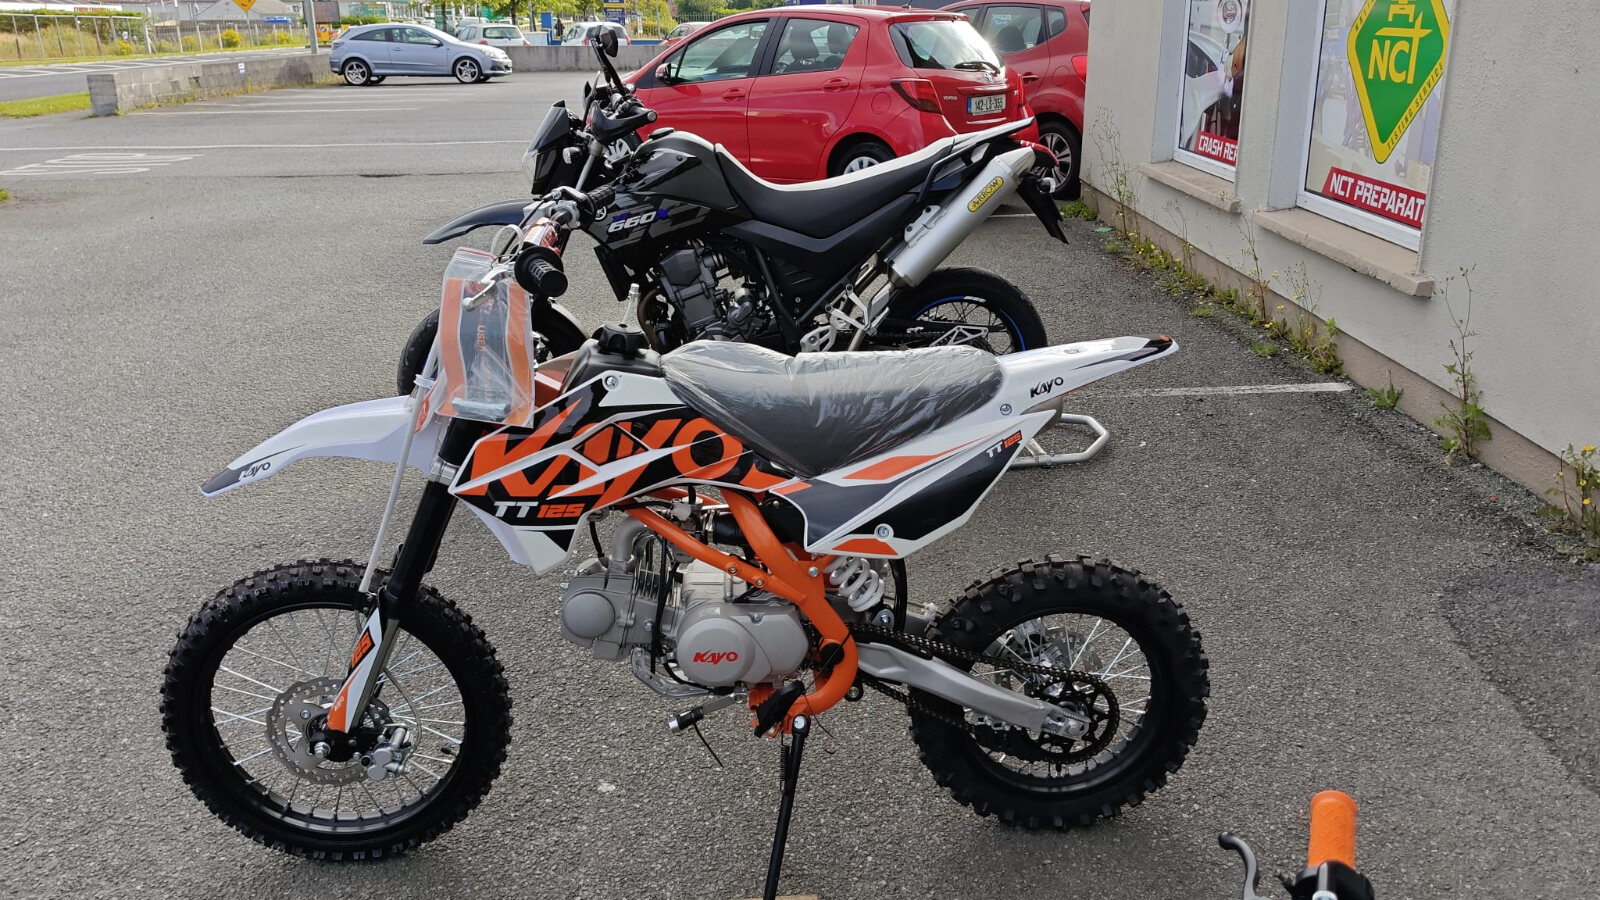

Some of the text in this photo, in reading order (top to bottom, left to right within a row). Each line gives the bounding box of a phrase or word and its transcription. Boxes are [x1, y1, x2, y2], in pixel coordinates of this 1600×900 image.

[1367, 10, 1433, 84] NCT
[1387, 61, 1444, 150] TESTING SERVICE
[1198, 134, 1224, 158] CRASH
[972, 179, 999, 208] ARROW
[1329, 172, 1355, 198] NCT
[1029, 376, 1064, 398] KAYO
[986, 440, 1004, 458] TT
[494, 501, 586, 519] TT 125
[693, 650, 739, 665] KAYO
